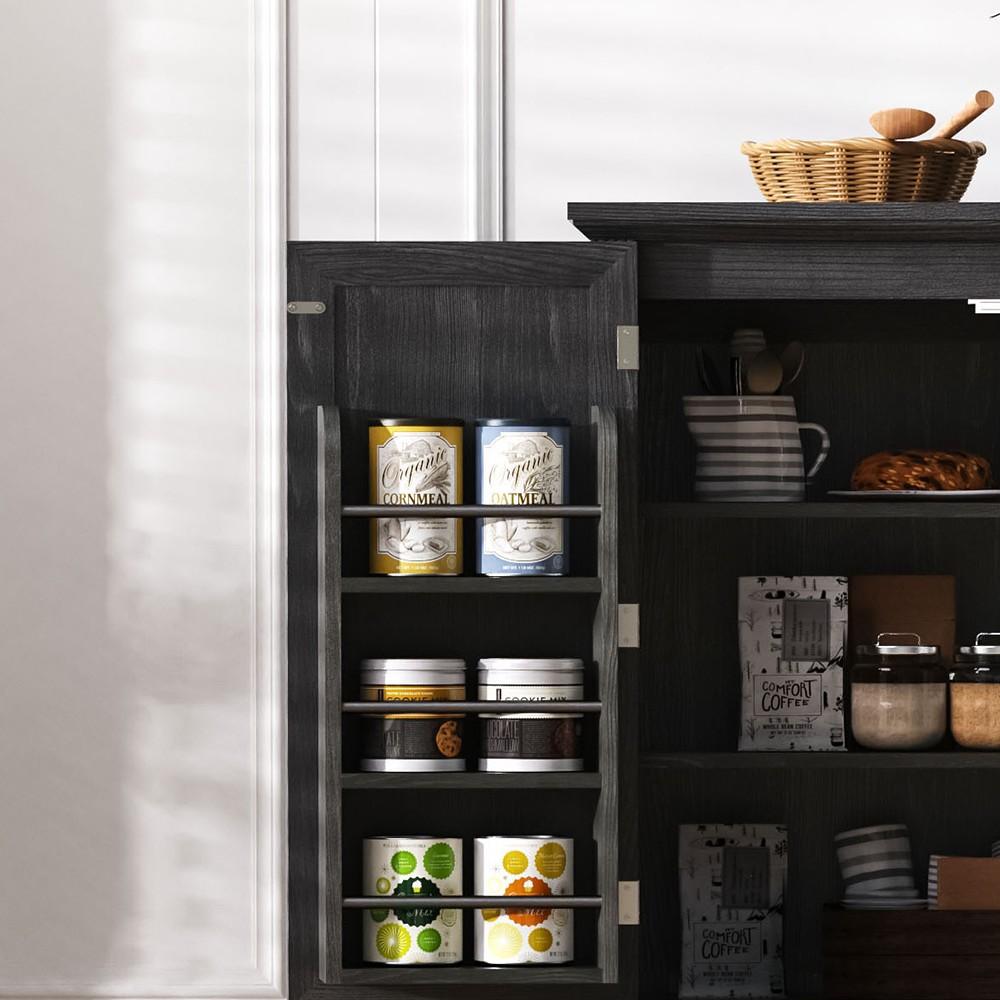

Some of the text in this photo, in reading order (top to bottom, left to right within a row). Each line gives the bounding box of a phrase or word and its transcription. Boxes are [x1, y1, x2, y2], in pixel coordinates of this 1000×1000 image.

[382, 447, 448, 489] Organic
[488, 448, 553, 488] Organic
[383, 492, 451, 505] CORNMEAL
[491, 492, 556, 505] OATMEAL
[762, 679, 818, 698] COMFORT
[762, 692, 810, 712] COFFEE
[702, 927, 757, 947] COMFORT
[702, 940, 751, 960] COFFEE
